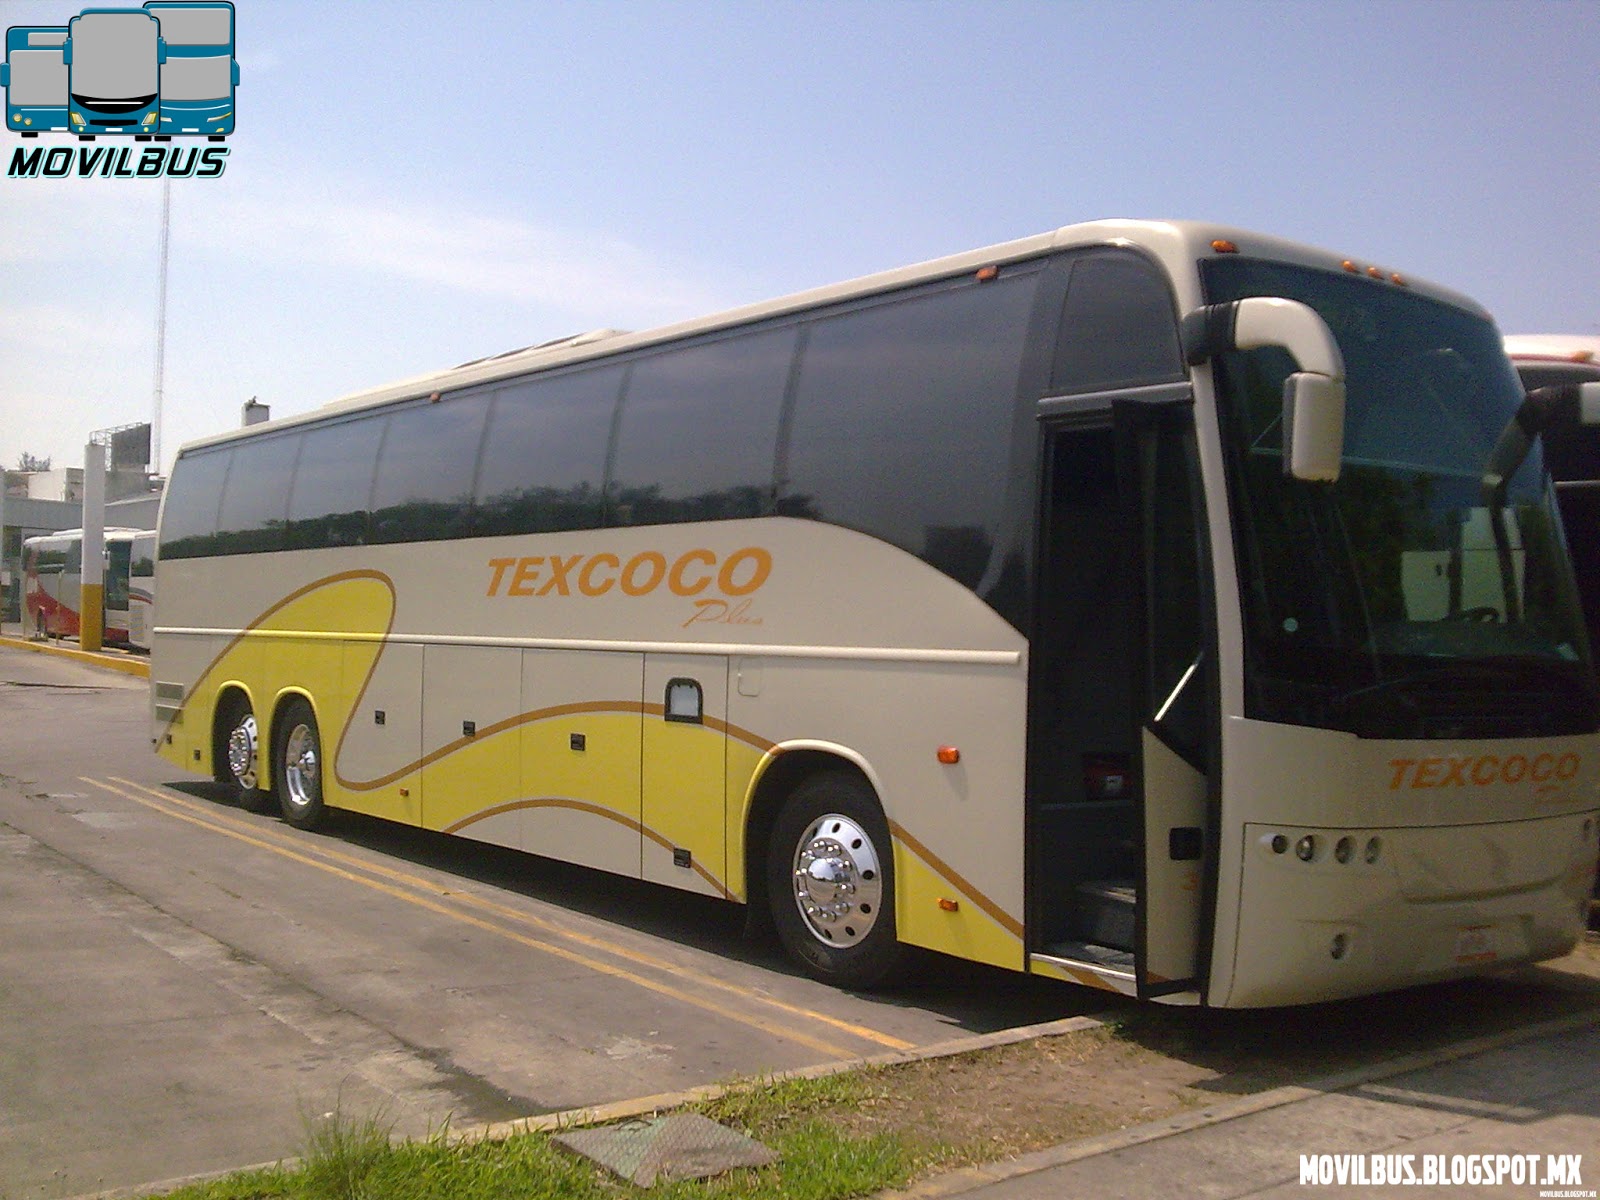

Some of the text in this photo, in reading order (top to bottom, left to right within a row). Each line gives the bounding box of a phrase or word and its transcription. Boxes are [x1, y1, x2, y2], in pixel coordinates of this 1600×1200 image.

[486, 547, 772, 597] TEXCOCO
[682, 598, 763, 628] Plus
[1389, 752, 1582, 790] TEXCOCO
